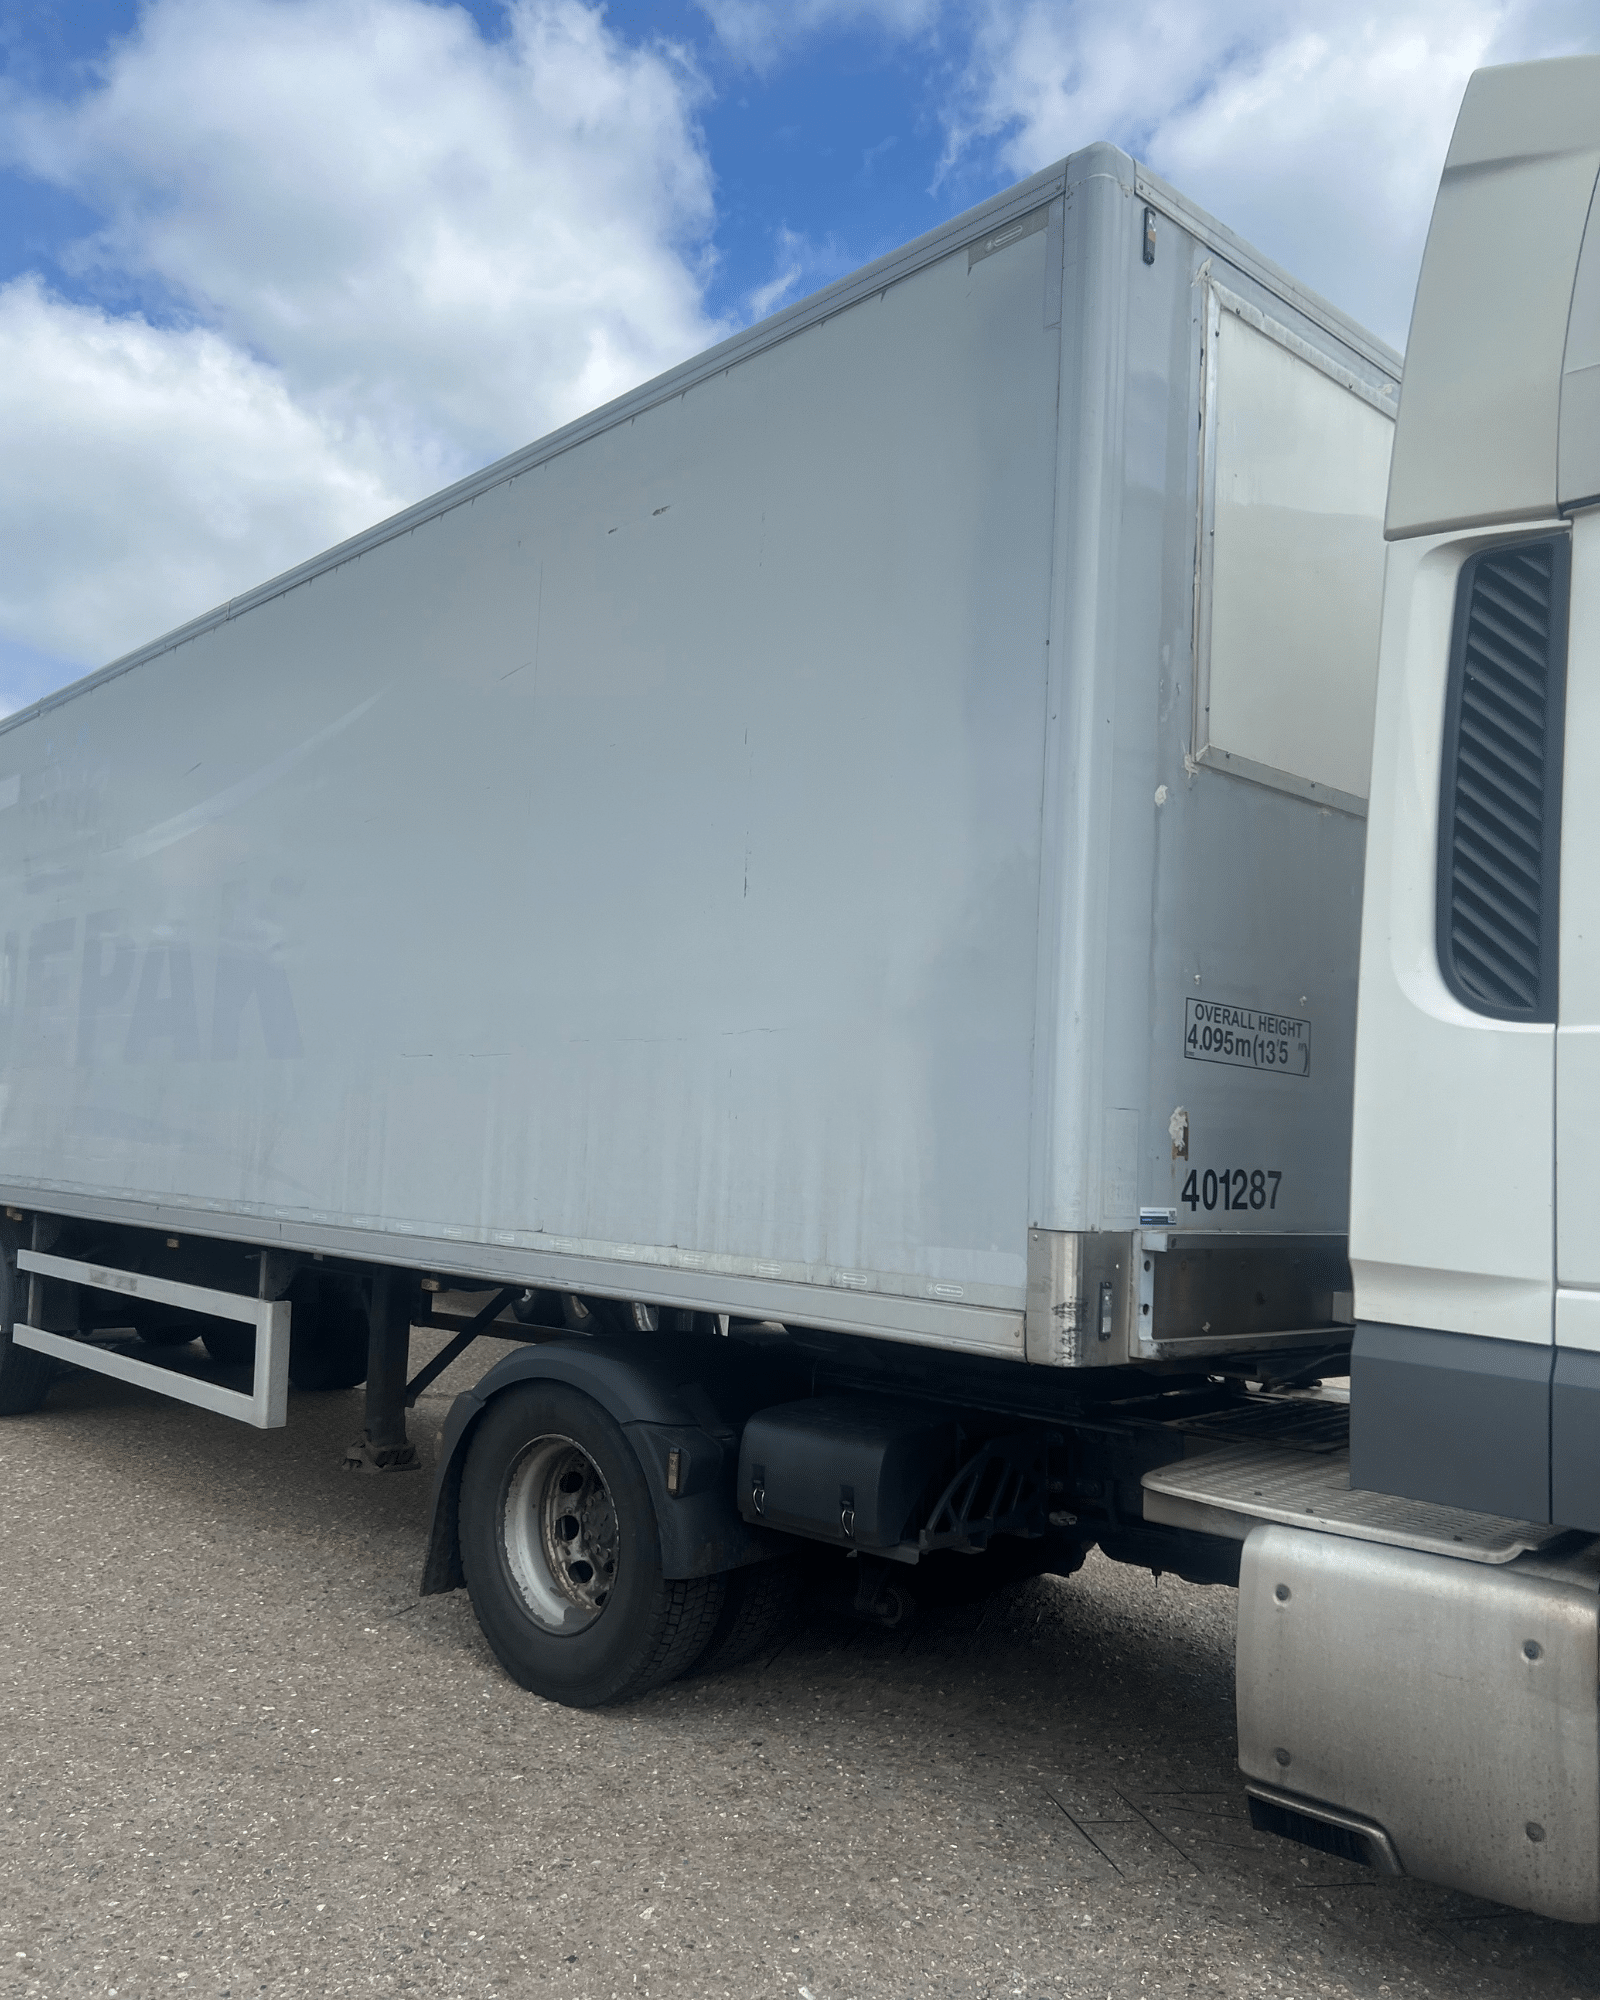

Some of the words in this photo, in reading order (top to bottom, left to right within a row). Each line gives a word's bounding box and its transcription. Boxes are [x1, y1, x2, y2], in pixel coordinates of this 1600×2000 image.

[1195, 1003, 1255, 1030] OVERALL
[1259, 1015, 1303, 1038] HEIGHT
[1181, 1168, 1282, 1211] 401287
